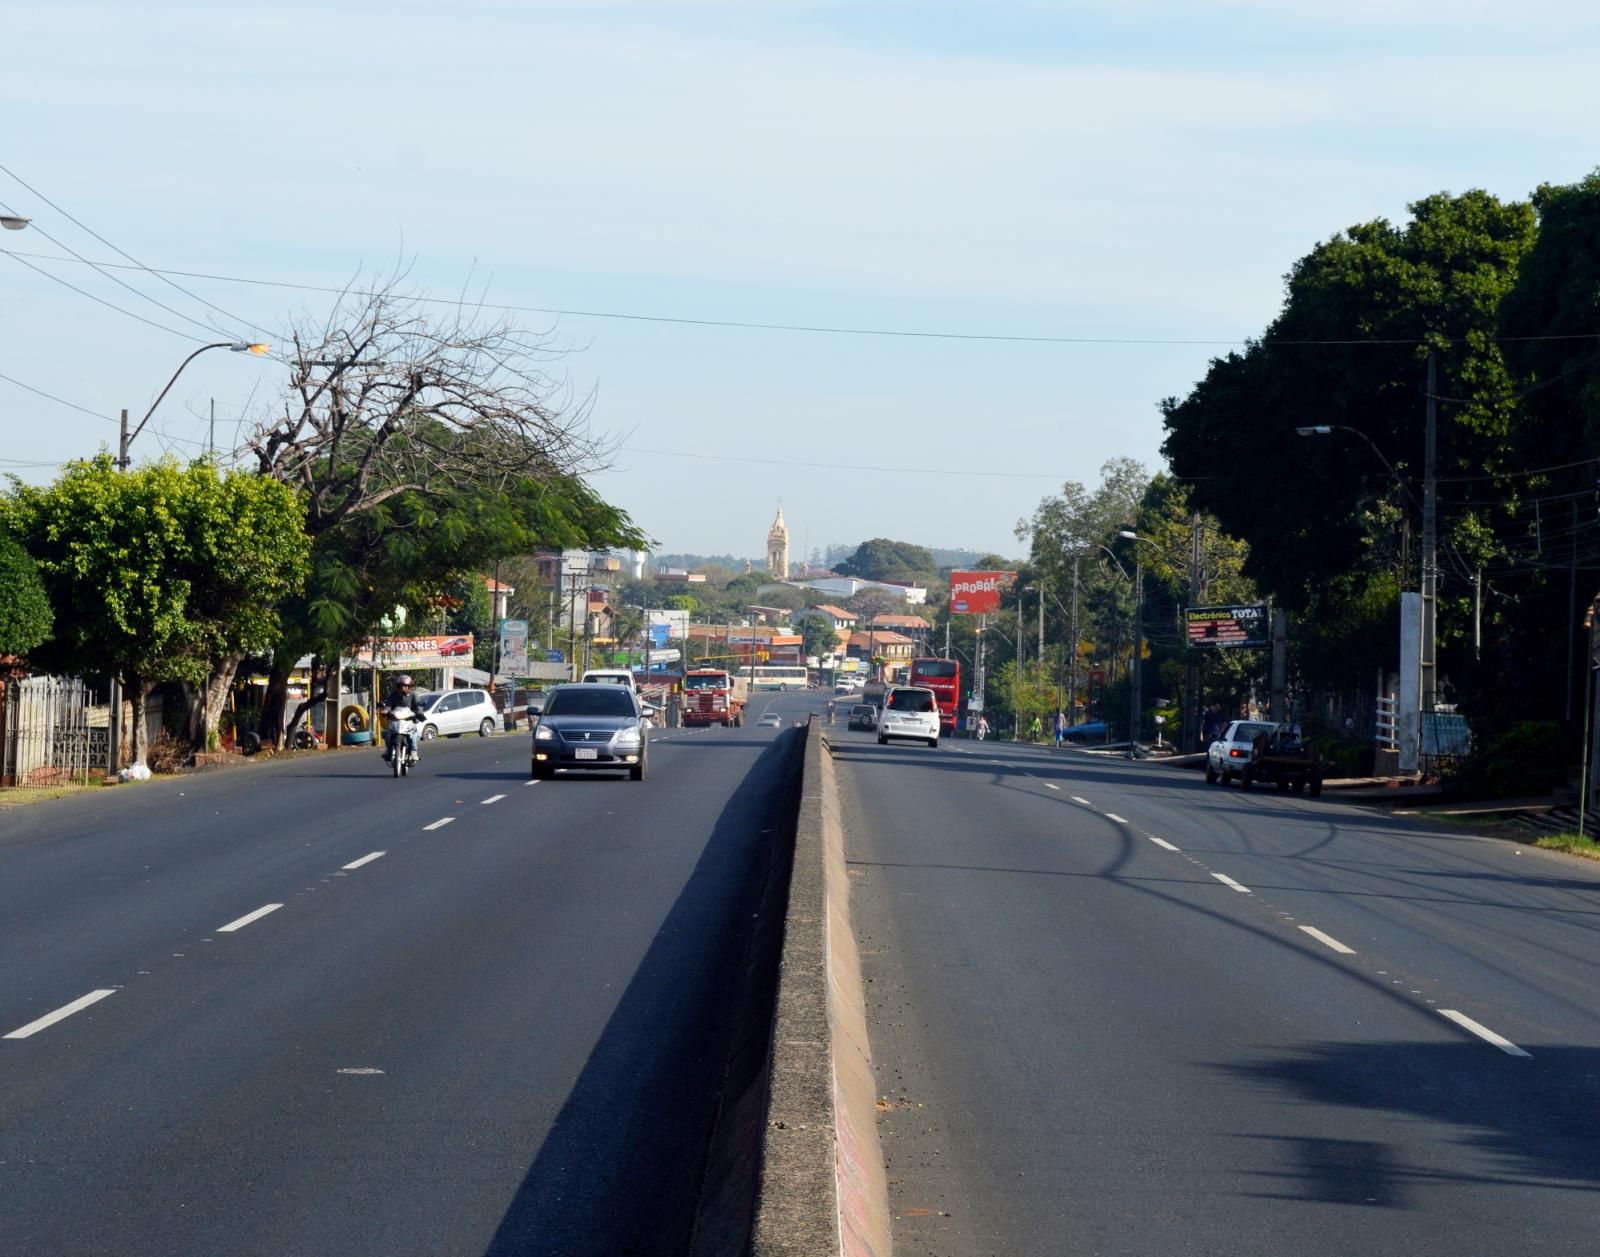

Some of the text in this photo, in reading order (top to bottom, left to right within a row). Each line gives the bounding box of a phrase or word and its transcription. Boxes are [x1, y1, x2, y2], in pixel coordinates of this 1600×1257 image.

[951, 577, 994, 600] ¡PROBÁ!
[1231, 608, 1263, 619] TOTAL
[359, 639, 437, 651] AUMOTORES
[53, 743, 109, 754] MECANIC
